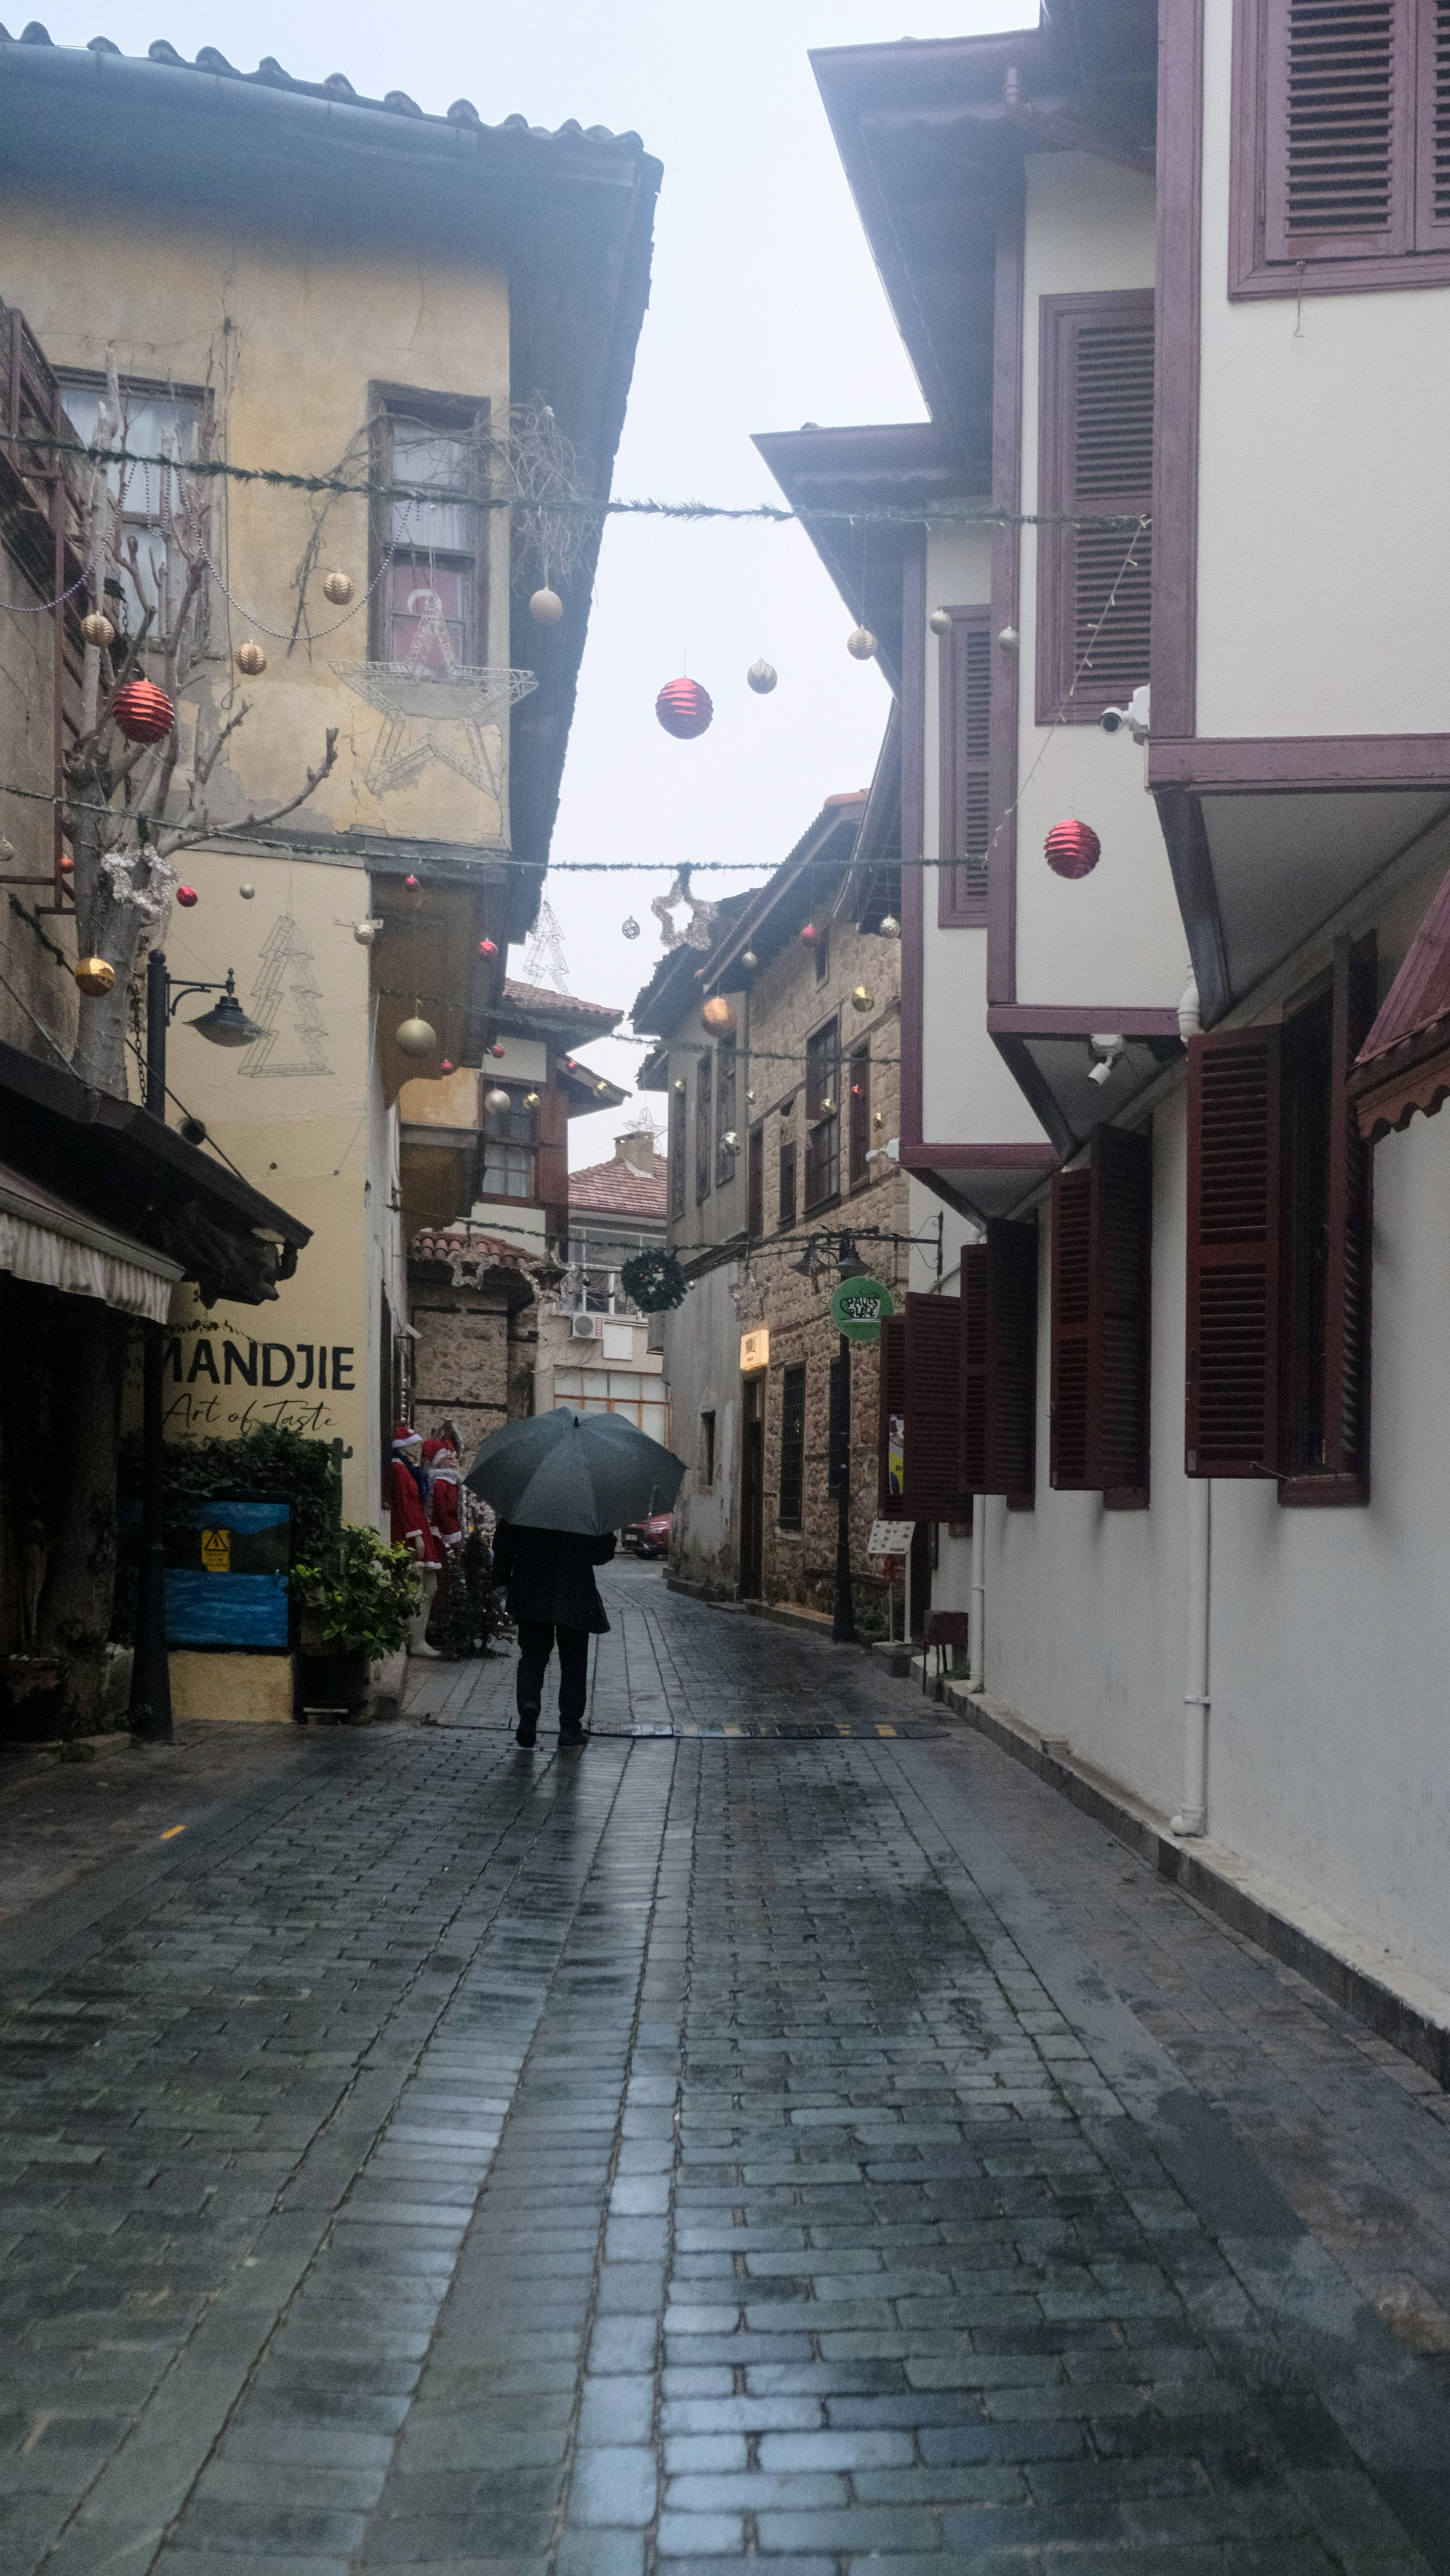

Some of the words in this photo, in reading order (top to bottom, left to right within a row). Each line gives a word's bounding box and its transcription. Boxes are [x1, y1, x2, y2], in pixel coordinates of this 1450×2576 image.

[848, 1306, 874, 1318] PLACE
[163, 1392, 220, 1429] Art
[228, 1400, 260, 1432] of
[263, 1400, 338, 1431] Taste
